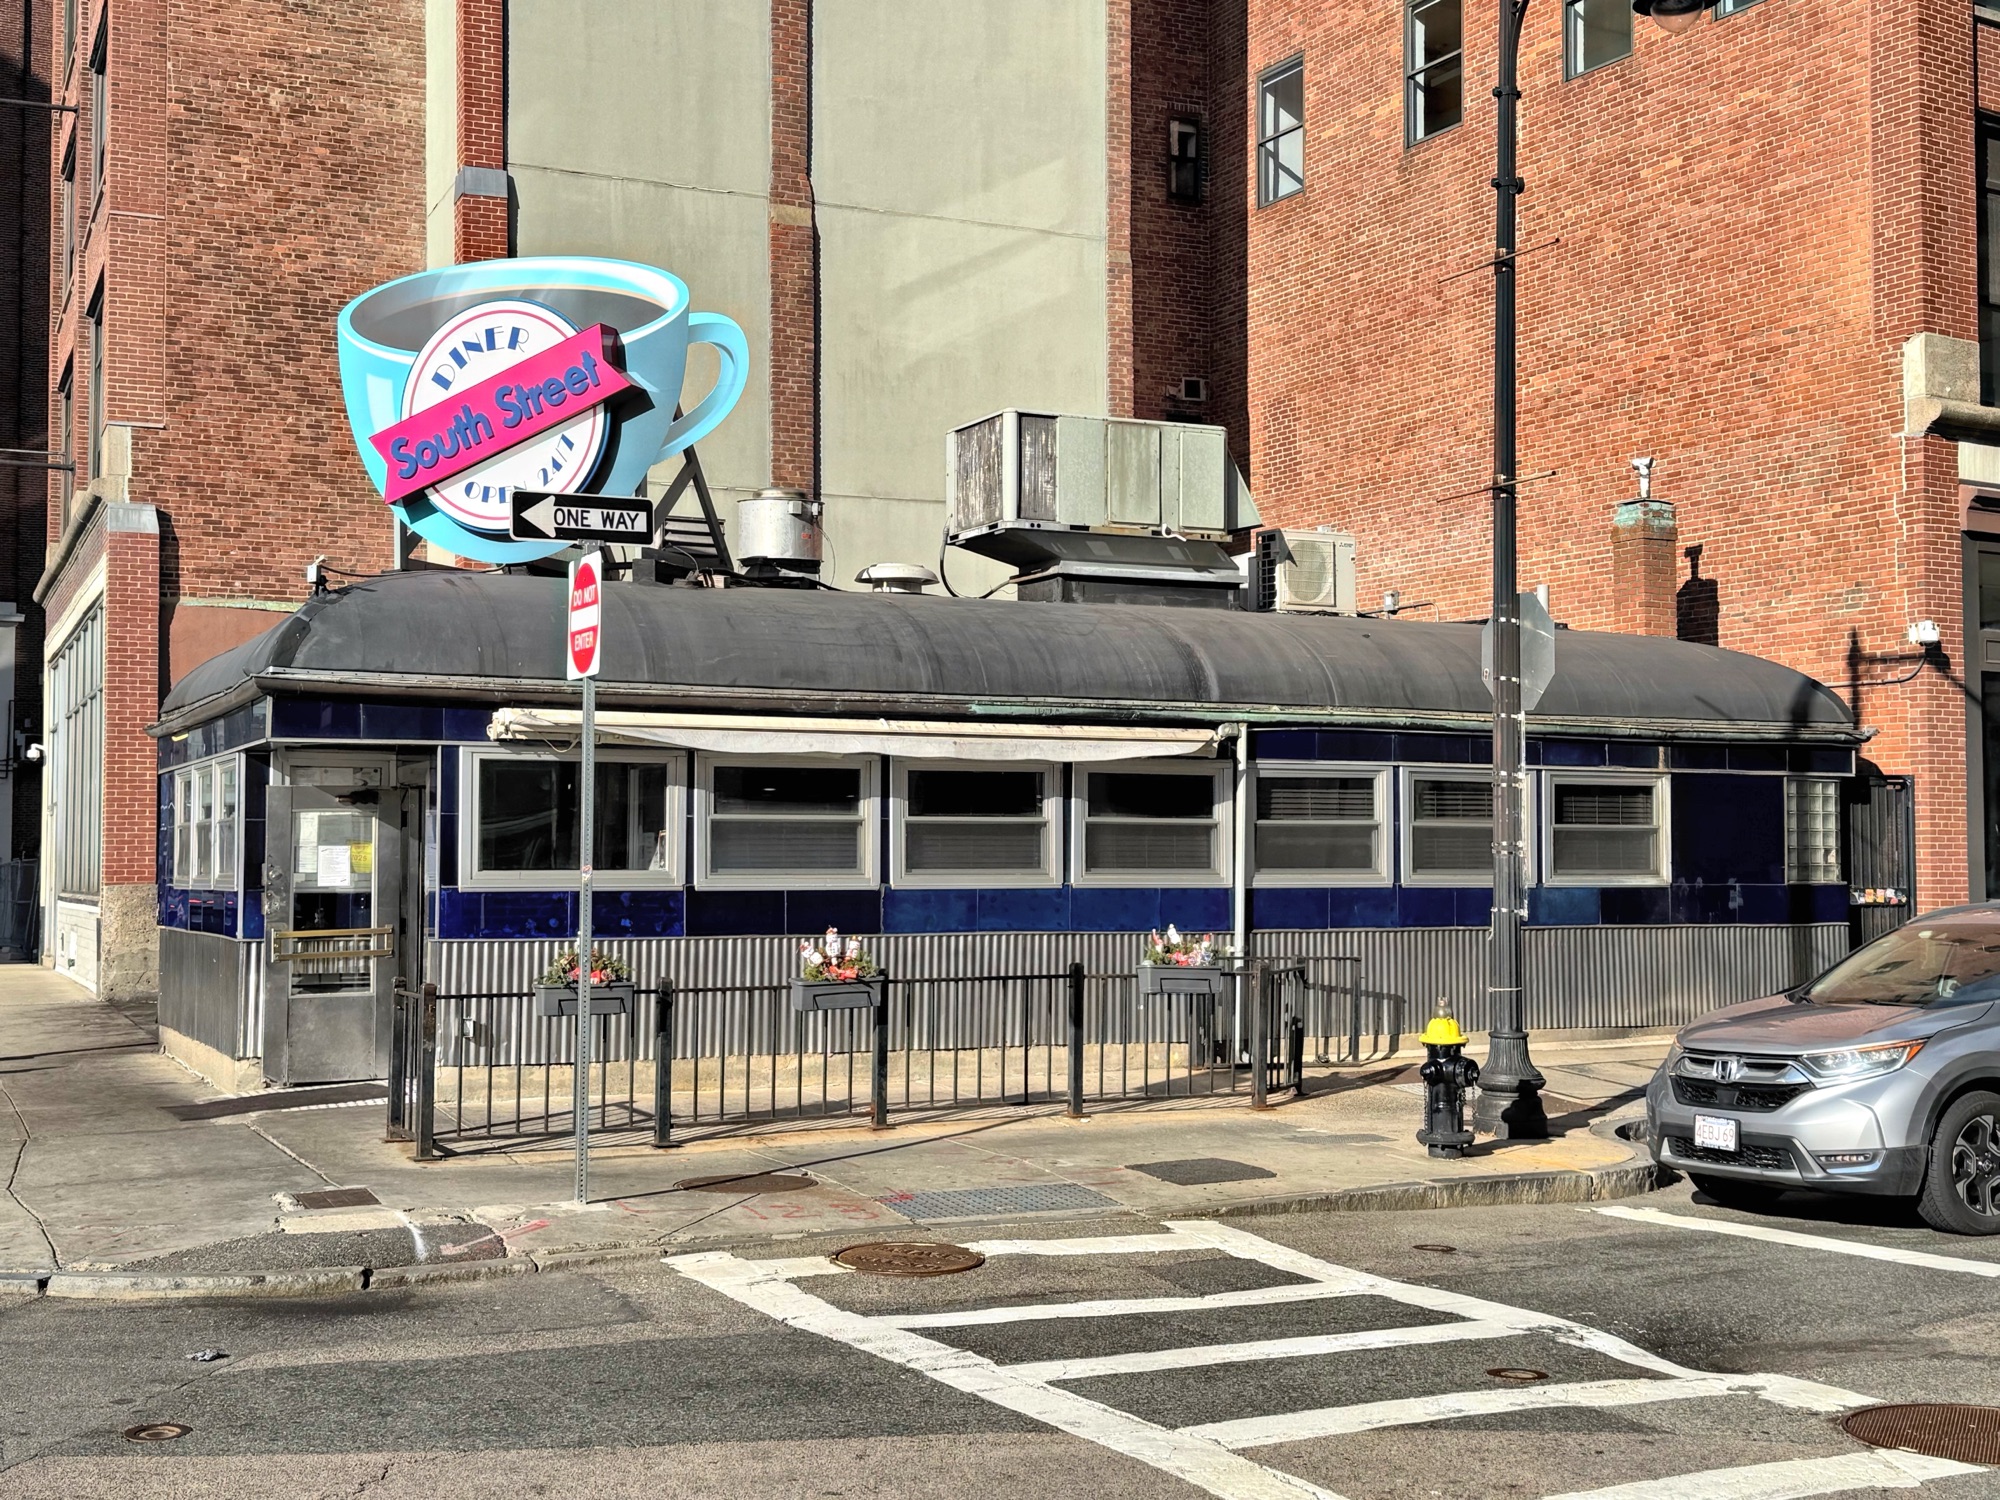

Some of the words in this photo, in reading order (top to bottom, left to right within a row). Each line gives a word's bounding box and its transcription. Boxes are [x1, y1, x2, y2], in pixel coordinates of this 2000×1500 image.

[431, 325, 530, 391] DINER
[391, 404, 495, 480] South
[494, 350, 602, 428] Street
[537, 433, 575, 487] 24/7
[554, 507, 592, 528] ONE
[600, 510, 640, 530] WAY
[573, 588, 583, 607] DO
[583, 584, 597, 604] NOT
[574, 630, 594, 652] ENTER
